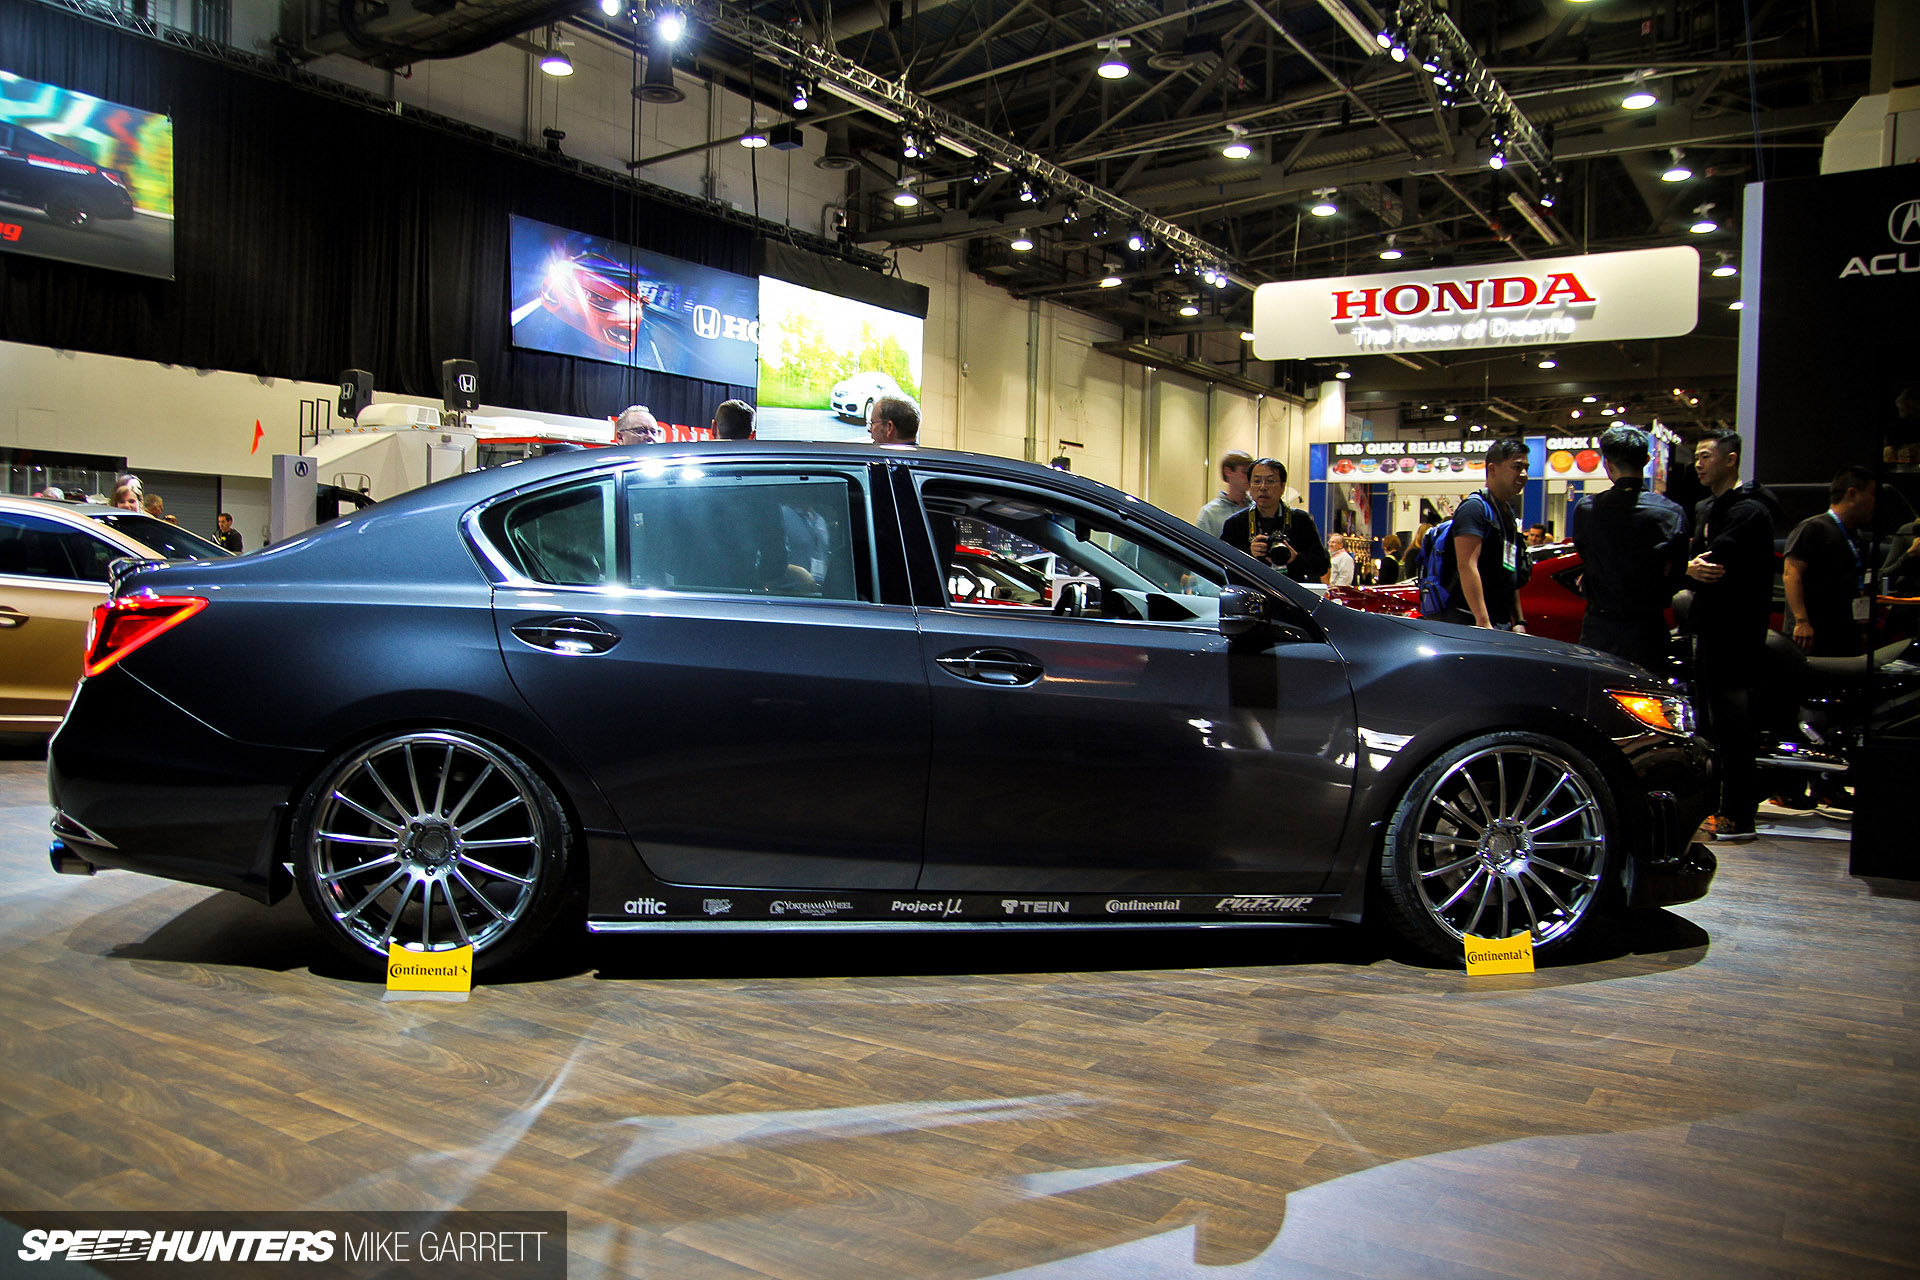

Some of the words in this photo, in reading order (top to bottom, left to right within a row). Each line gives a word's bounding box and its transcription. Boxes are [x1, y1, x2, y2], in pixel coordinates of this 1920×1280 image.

[0, 221, 23, 242] g
[1331, 272, 1596, 320] HONDA
[1351, 326, 1391, 345] The
[1394, 324, 1462, 343] Power
[1462, 319, 1488, 339] of
[1490, 317, 1576, 338] Dreams
[1336, 444, 1364, 455] NRG
[1366, 443, 1405, 454] QUICK
[1408, 441, 1461, 453] RELEASE
[1546, 437, 1589, 449] QUICK
[624, 898, 667, 914] attic
[1020, 901, 1069, 913] TEIN
[1105, 899, 1180, 913] Continental
[1467, 949, 1523, 965] Continental
[389, 963, 458, 978] Continental
